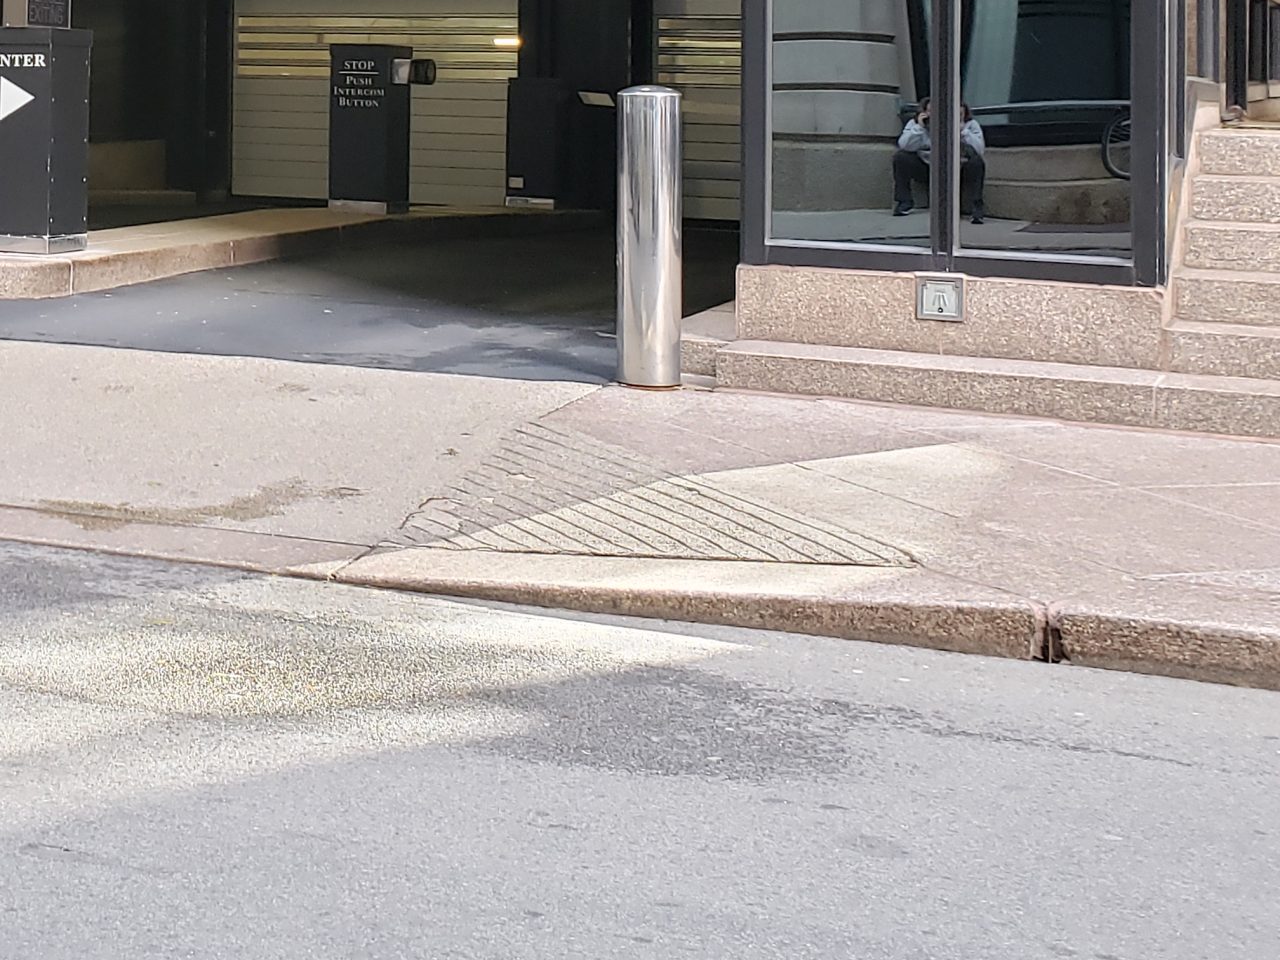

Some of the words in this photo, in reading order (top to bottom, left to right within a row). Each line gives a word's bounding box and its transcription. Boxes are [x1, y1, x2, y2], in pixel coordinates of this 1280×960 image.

[29, 4, 65, 25] EXITING
[344, 60, 375, 70] STOP
[346, 76, 373, 86] PUSH
[333, 86, 385, 97] INTERCOM
[338, 97, 379, 107] BUTTON
